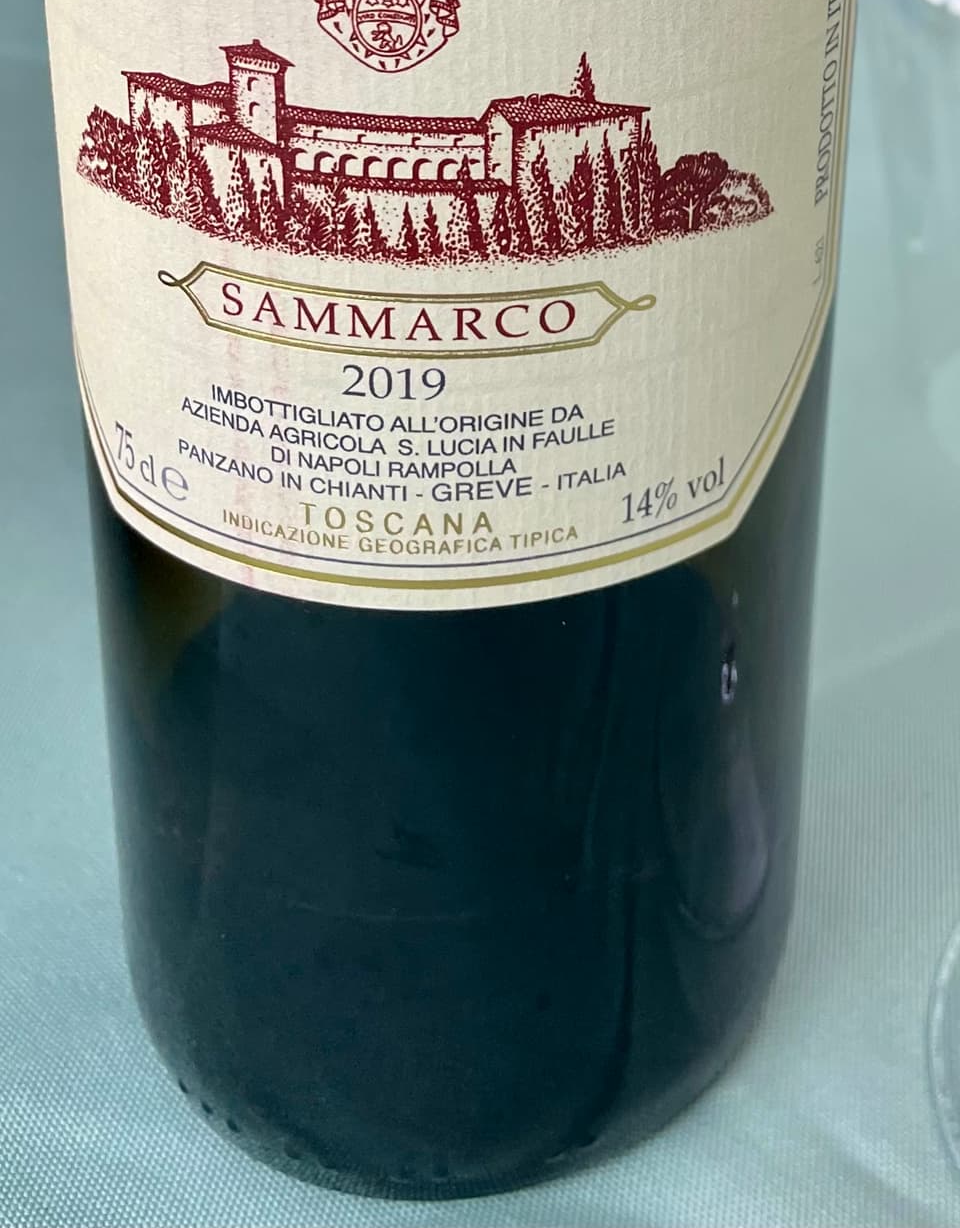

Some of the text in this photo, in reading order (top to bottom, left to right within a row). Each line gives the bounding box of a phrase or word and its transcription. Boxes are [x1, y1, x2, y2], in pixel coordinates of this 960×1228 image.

[823, 22, 840, 59] IN
[814, 59, 838, 207] PRODOTTO
[221, 282, 577, 342] SAMMARCO
[342, 365, 446, 401] 2019
[181, 397, 615, 456] AZIENDA AGRICOLA S. LUCIA IN FAULLE
[211, 384, 385, 432] IMBOTTIGLIATO
[551, 404, 584, 424] DA
[114, 420, 135, 471] 75
[271, 446, 517, 479] DI NAPOLI RAMPOLLA
[178, 439, 273, 484] PANZANO
[281, 471, 301, 490] IN
[310, 478, 407, 502] CHIANTI
[431, 476, 533, 502] GREVE
[557, 462, 626, 491] ITALIA
[621, 456, 725, 525] 14% vol
[222, 508, 579, 555] INDICAZIONE GEOGRAFICA TIPICA
[299, 502, 493, 536] TOSCANA
